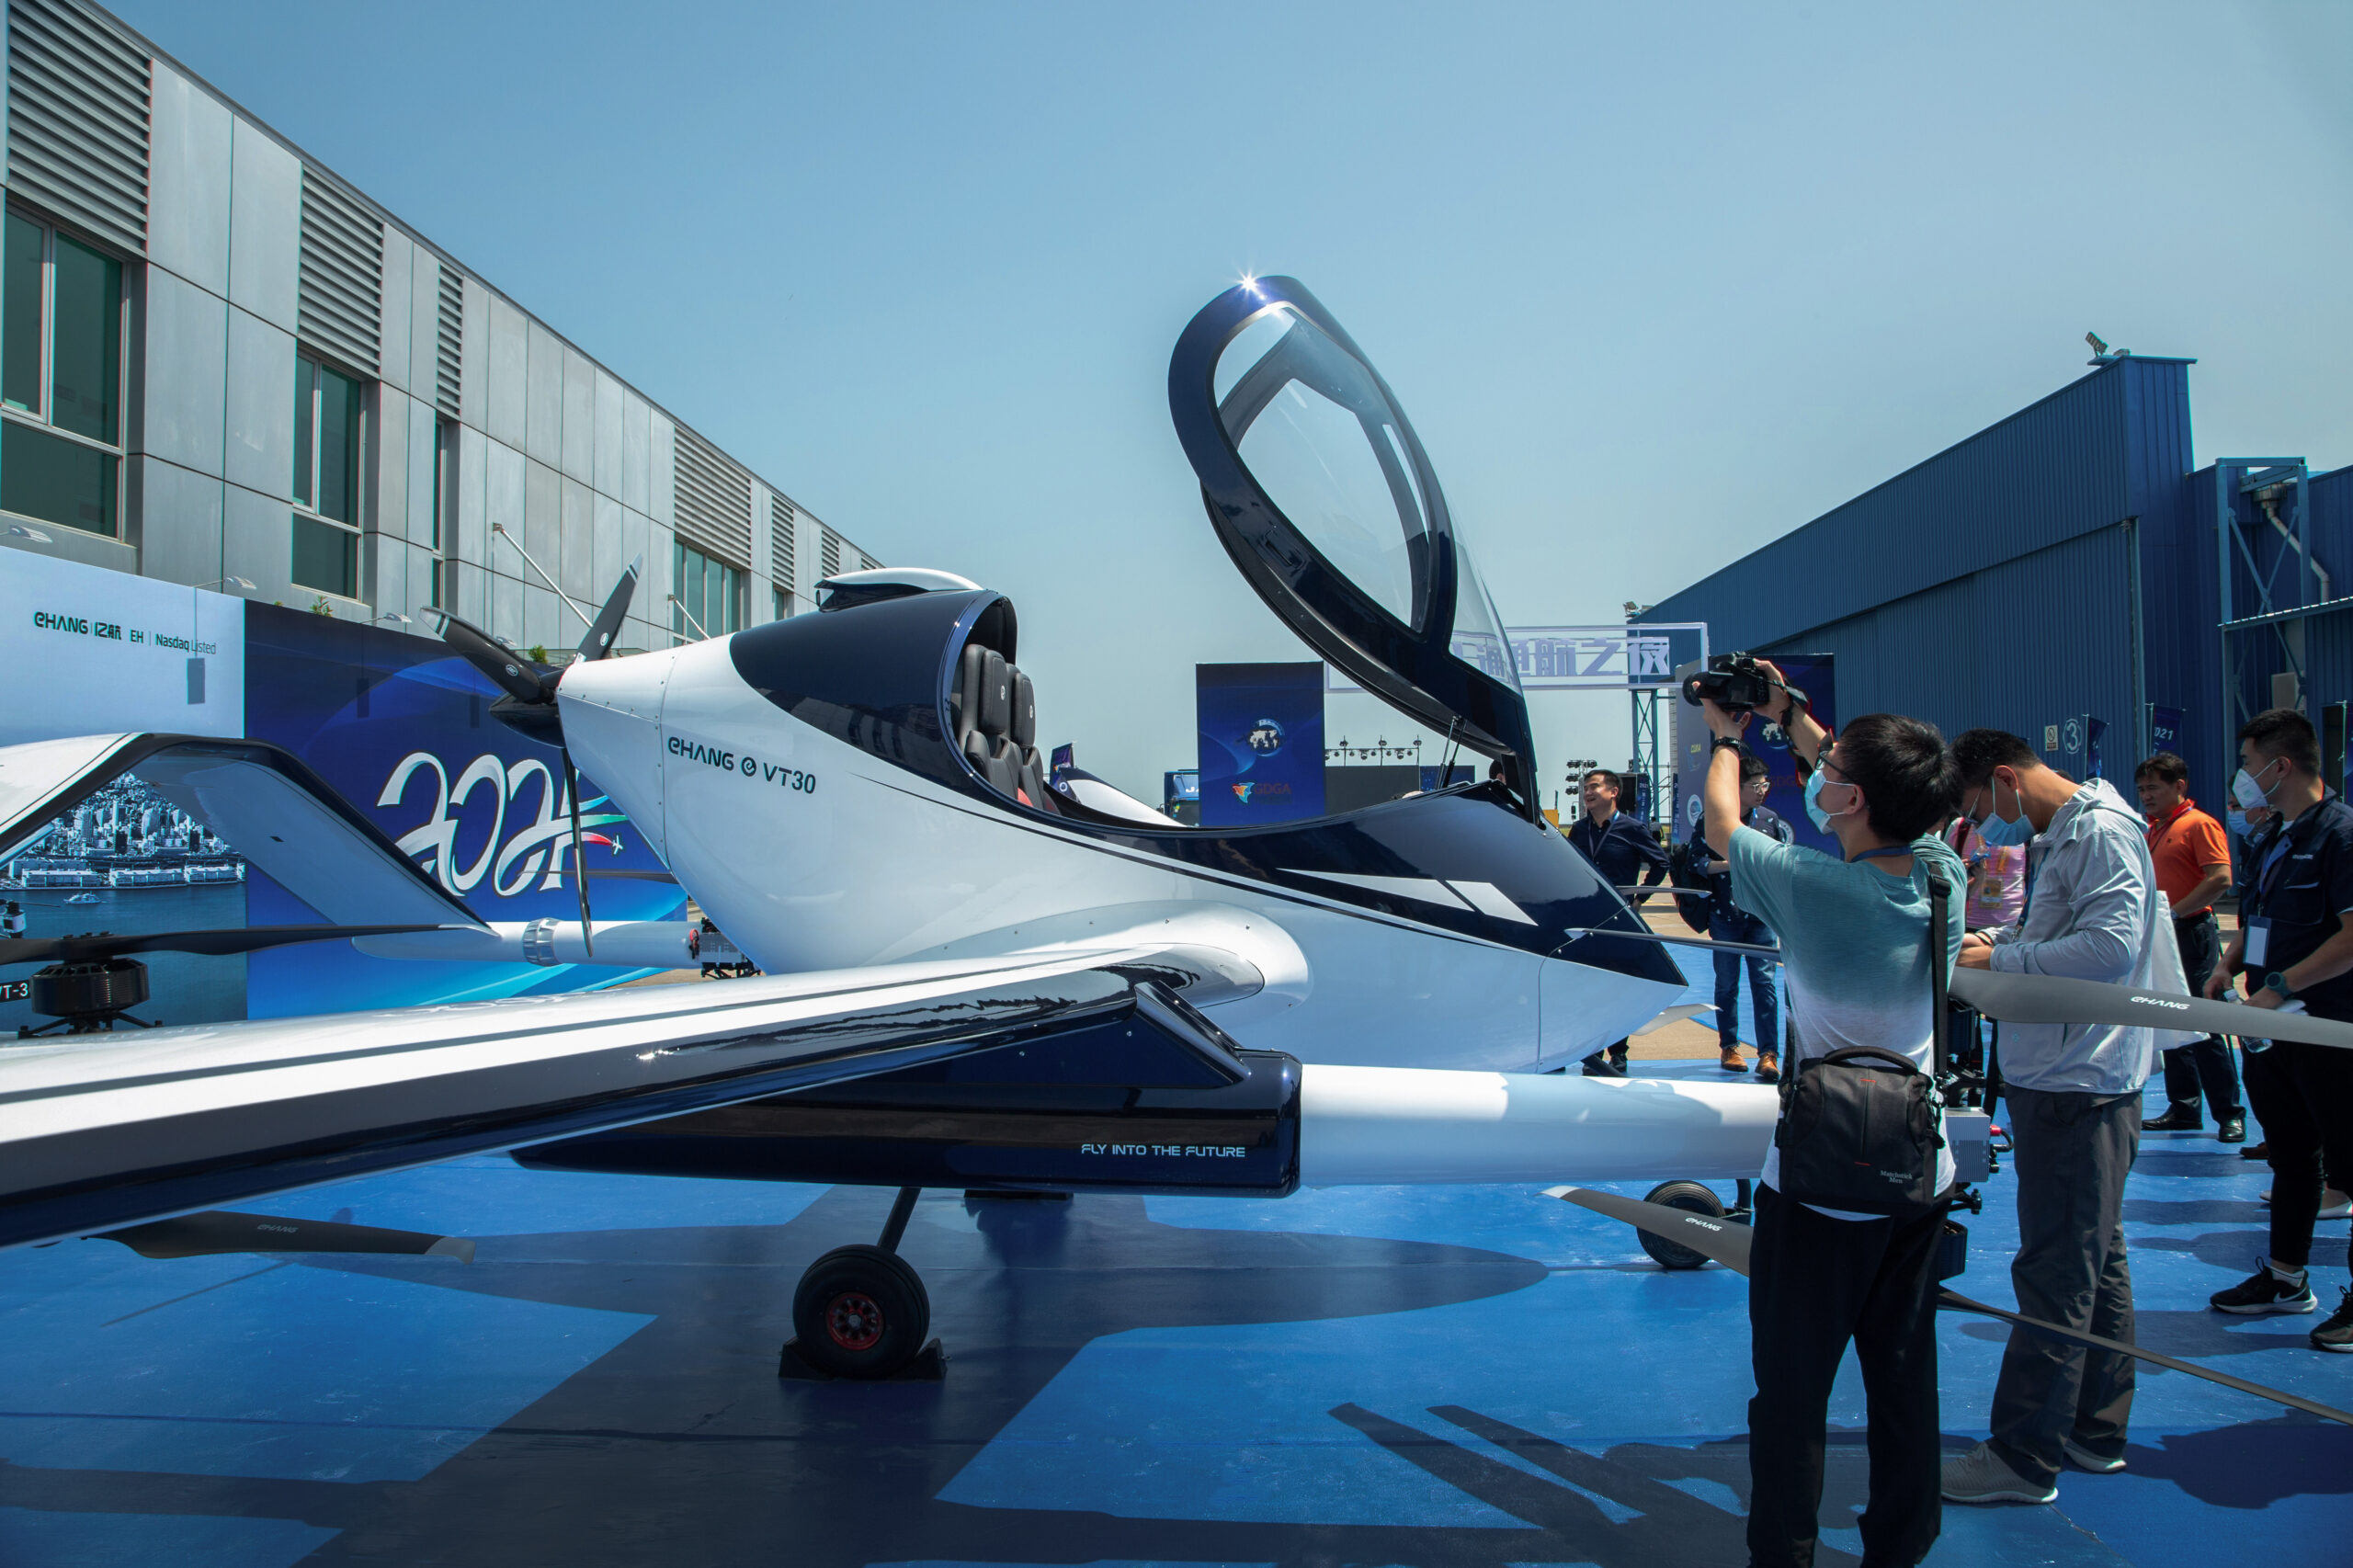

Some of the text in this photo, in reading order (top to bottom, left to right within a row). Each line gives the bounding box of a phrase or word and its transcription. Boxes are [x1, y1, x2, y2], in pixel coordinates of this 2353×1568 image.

[131, 629, 216, 654] EH Nasdaq Listed
[2154, 726, 2174, 741] 021
[763, 762, 816, 794] VT30
[1081, 1143, 1245, 1158] FLY INTO THE FUTURE
